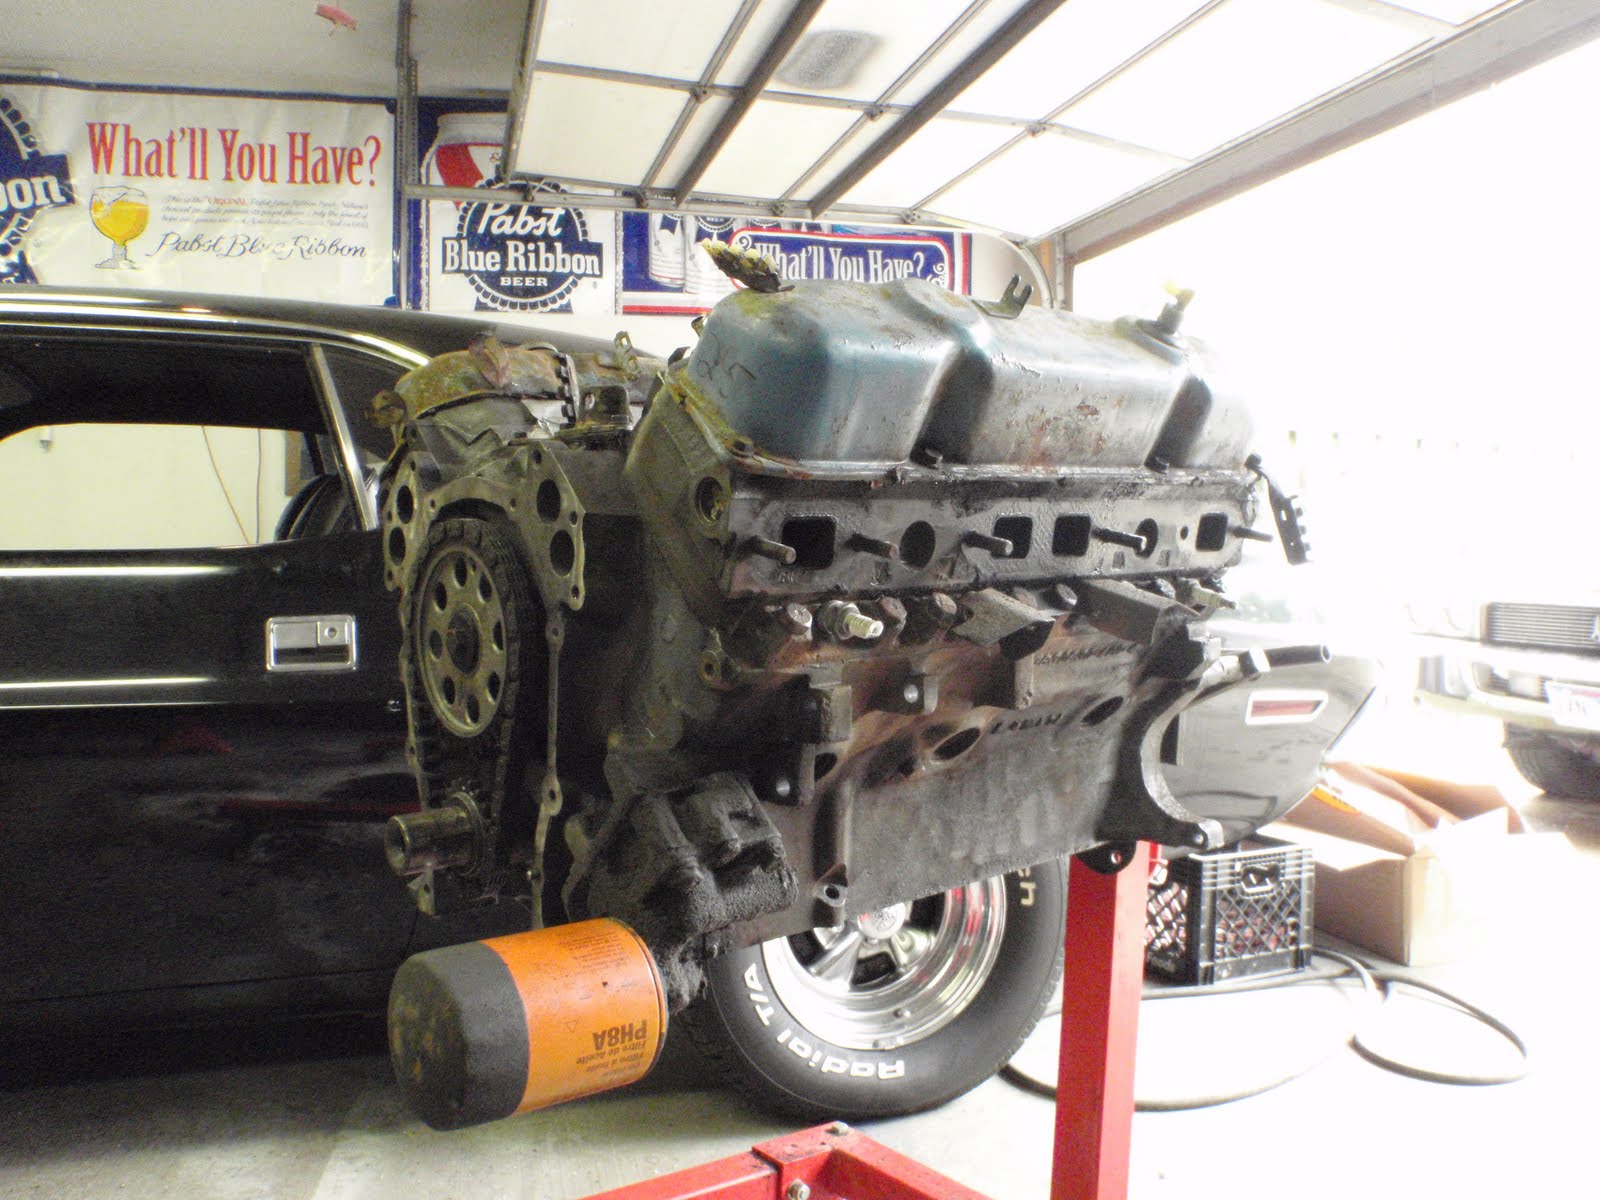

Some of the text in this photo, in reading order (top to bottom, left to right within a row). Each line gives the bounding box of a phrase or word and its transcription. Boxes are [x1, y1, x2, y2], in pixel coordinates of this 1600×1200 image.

[86, 121, 382, 187] What'll You Have?
[477, 202, 566, 237] Pabst
[144, 231, 226, 257] Pabst
[277, 234, 367, 260] Ribbon
[444, 239, 600, 275] Blue Ribbon
[500, 276, 548, 287] BEER
[829, 247, 865, 283] You
[867, 249, 925, 284] Have?
[592, 1019, 647, 1051] PH8A
[743, 962, 906, 1080] Radial T/A
